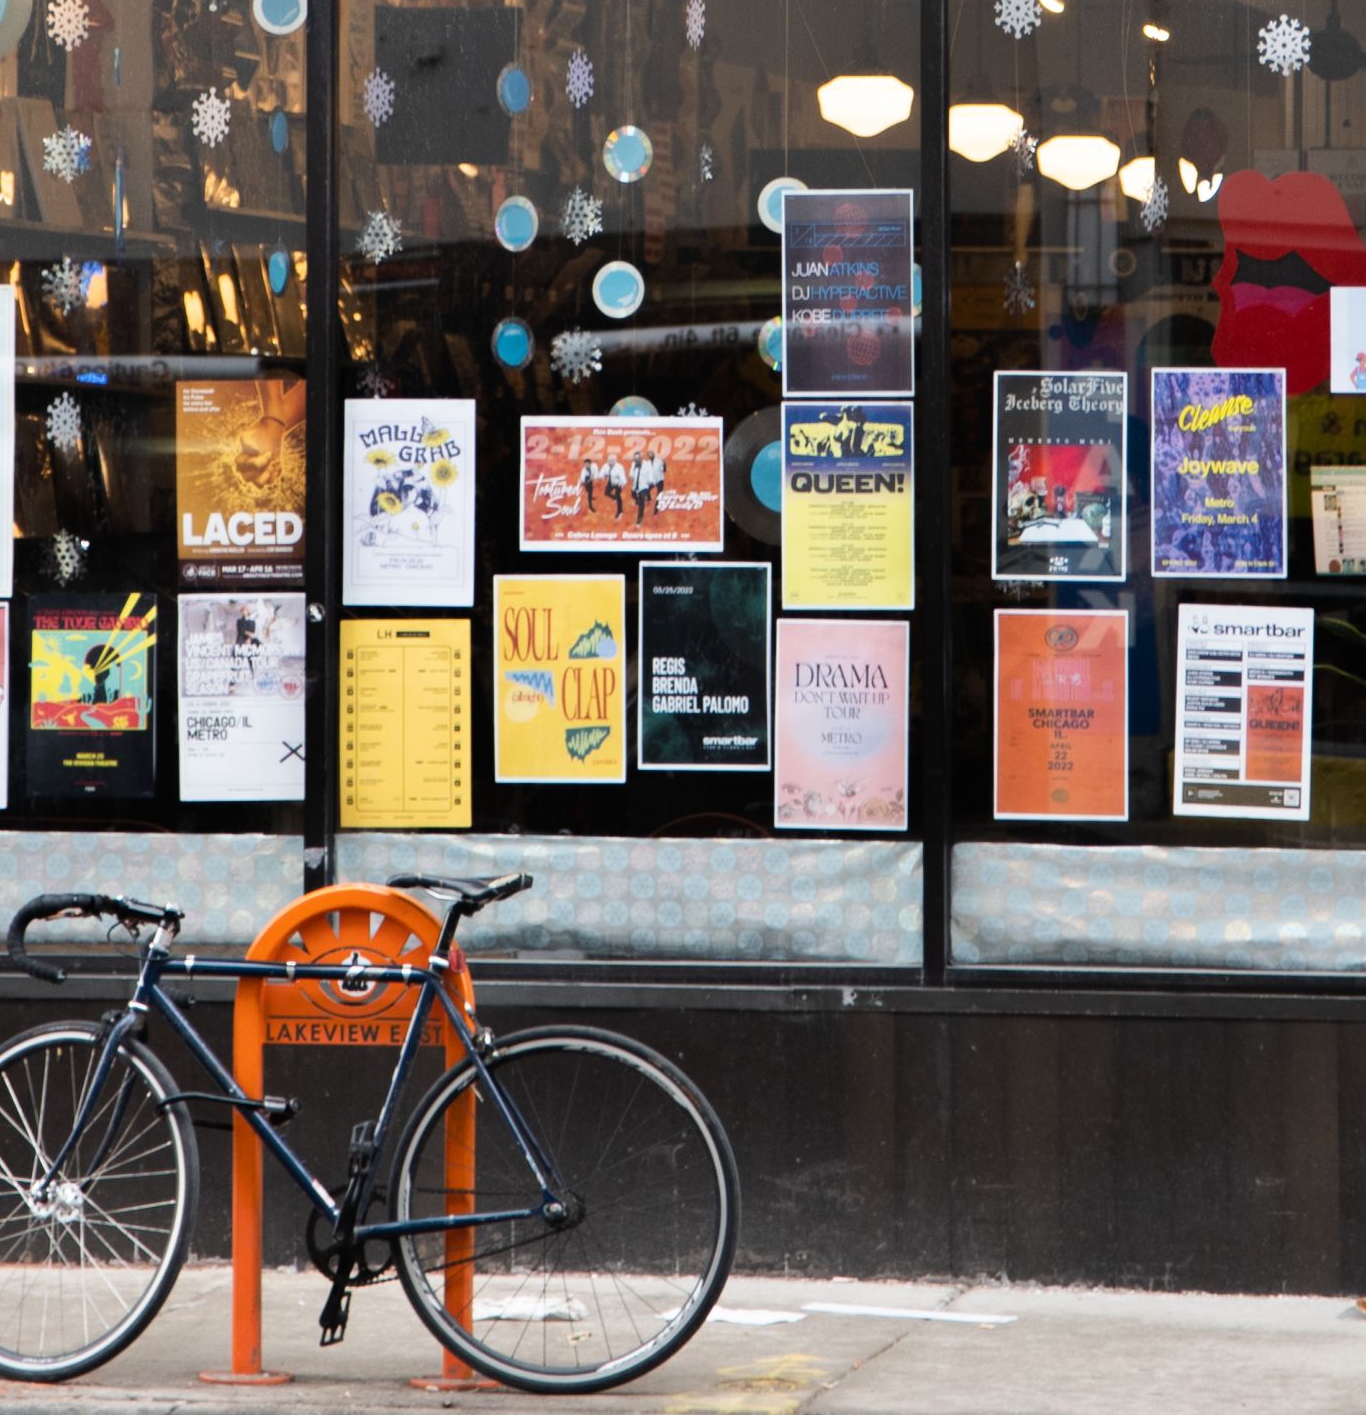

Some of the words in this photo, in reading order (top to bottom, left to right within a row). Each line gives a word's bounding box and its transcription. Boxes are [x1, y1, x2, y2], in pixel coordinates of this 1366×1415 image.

[791, 262, 829, 277] JUAN
[829, 262, 880, 276] ATKINS
[791, 285, 810, 300] DJ
[810, 285, 907, 300] HYPERACTIVE
[792, 309, 831, 323] KOBE
[1005, 394, 1063, 413] Iceberg
[1178, 394, 1254, 432] Cleanse
[359, 424, 423, 448] MALL
[526, 435, 719, 461] 2-12-2022
[1178, 457, 1259, 476] Joywave
[790, 472, 905, 494] QUEEN!
[1205, 497, 1234, 508] Metro
[1182, 514, 1214, 526] Friday,
[1217, 514, 1249, 524] March
[1251, 514, 1258, 524] 4
[182, 512, 303, 546] LACED
[503, 606, 559, 662] SOUL
[1214, 622, 1305, 638] smartbar
[652, 657, 685, 675] REGIS
[795, 663, 888, 688] DRAMA
[652, 677, 698, 694] BRENDA
[561, 666, 616, 721] CLAP
[795, 691, 834, 703] DON'T
[839, 691, 870, 704] WAIT
[873, 692, 890, 704] UP
[652, 696, 700, 713] GABRIEL
[703, 696, 749, 714] PALOMO
[824, 707, 860, 719] TOUR
[1028, 709, 1094, 719] SMARTBAR
[1032, 719, 1089, 729] CHICAGO
[1249, 719, 1299, 730] QUEEN!
[187, 729, 228, 741] METRO
[703, 736, 758, 746] smartbar
[821, 732, 862, 744] METRO
[1054, 751, 1067, 760] 22
[1048, 761, 1073, 770] 2022
[266, 1023, 380, 1043] LAKEVIEW
[390, 1025, 443, 1044] EST
